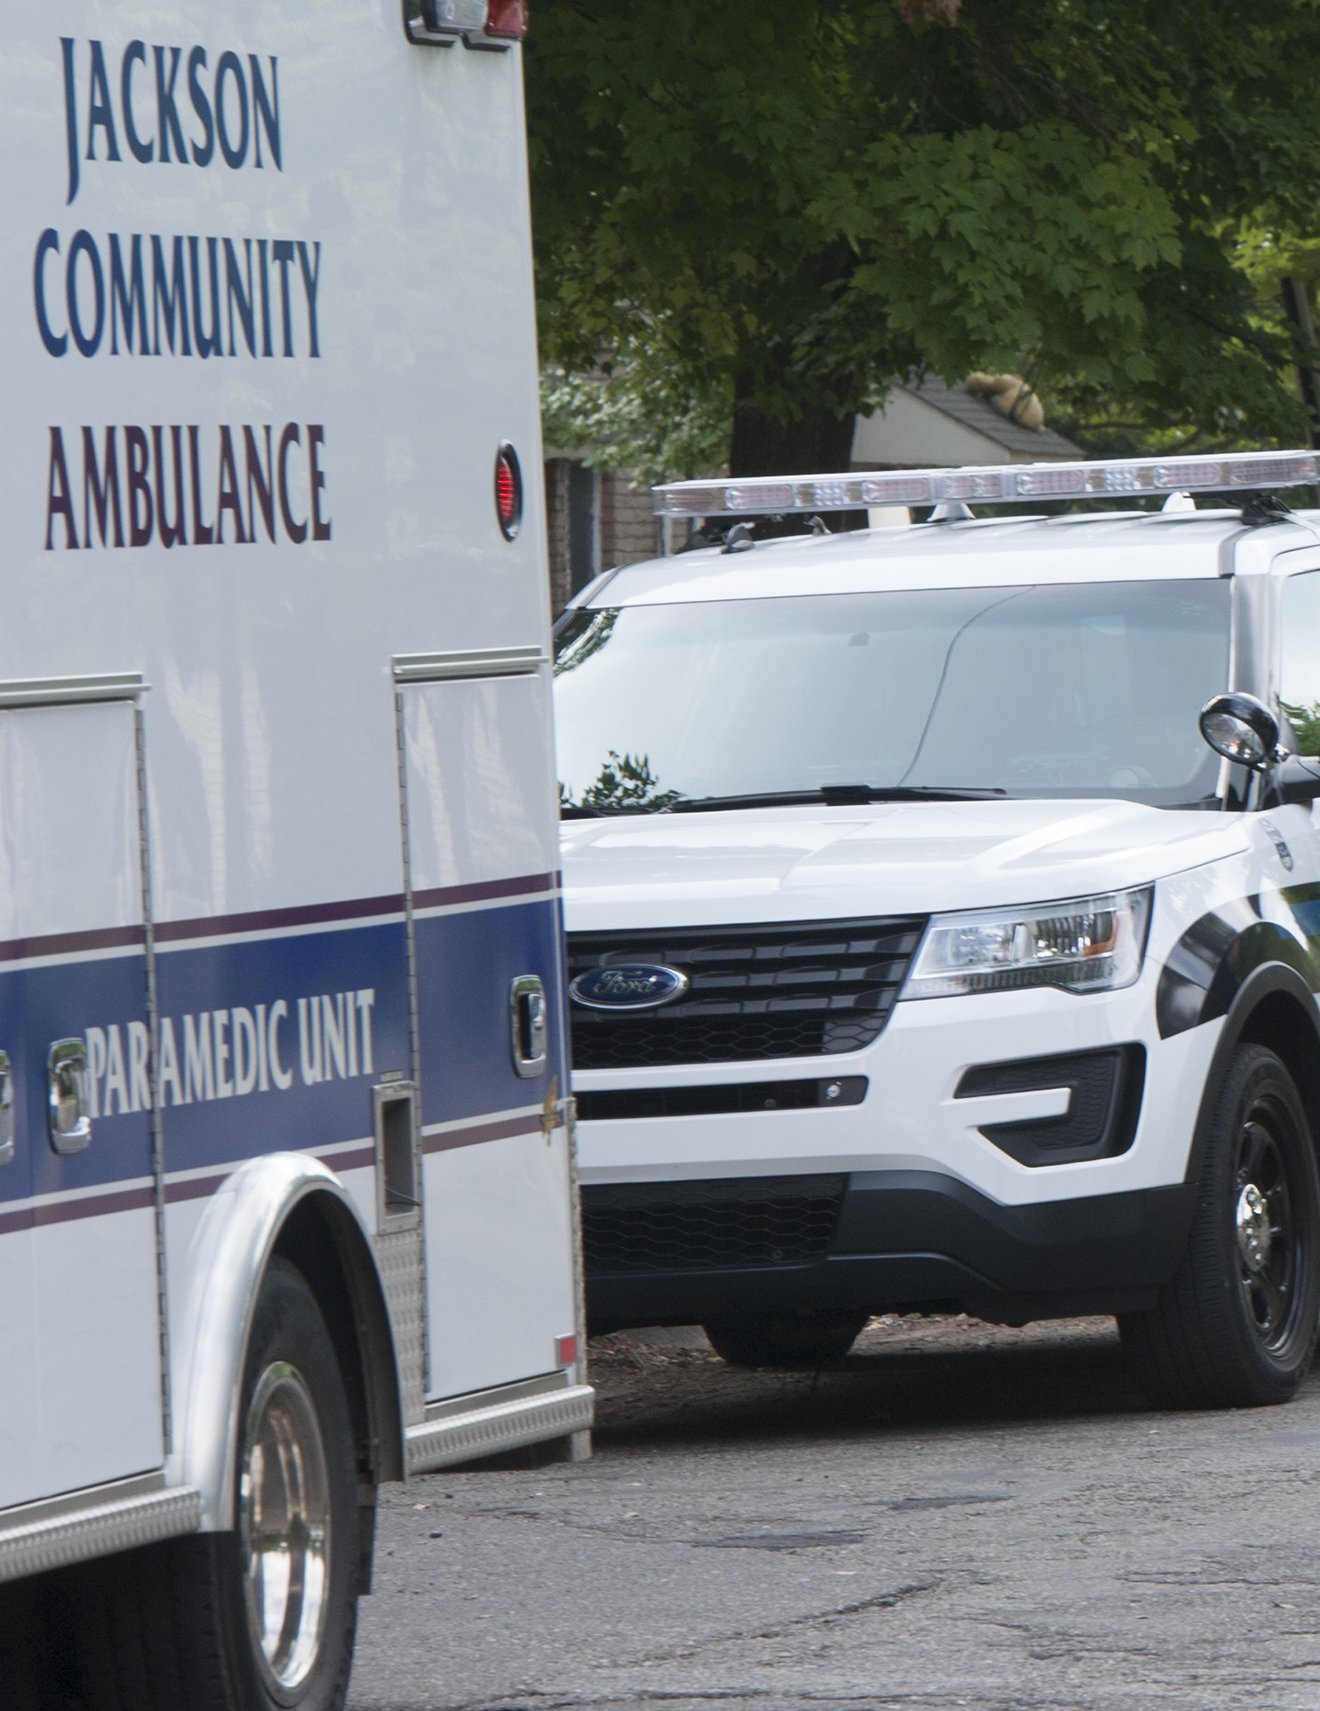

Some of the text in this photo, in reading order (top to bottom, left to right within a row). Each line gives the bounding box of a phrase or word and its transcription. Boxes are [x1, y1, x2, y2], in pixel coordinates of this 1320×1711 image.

[59, 37, 283, 205] JACKSON
[33, 227, 321, 359] COMMUNITY
[45, 422, 331, 549] AMBULANCE
[594, 970, 657, 994] Ford
[85, 989, 376, 1118] PARAMEDIC UNIT
